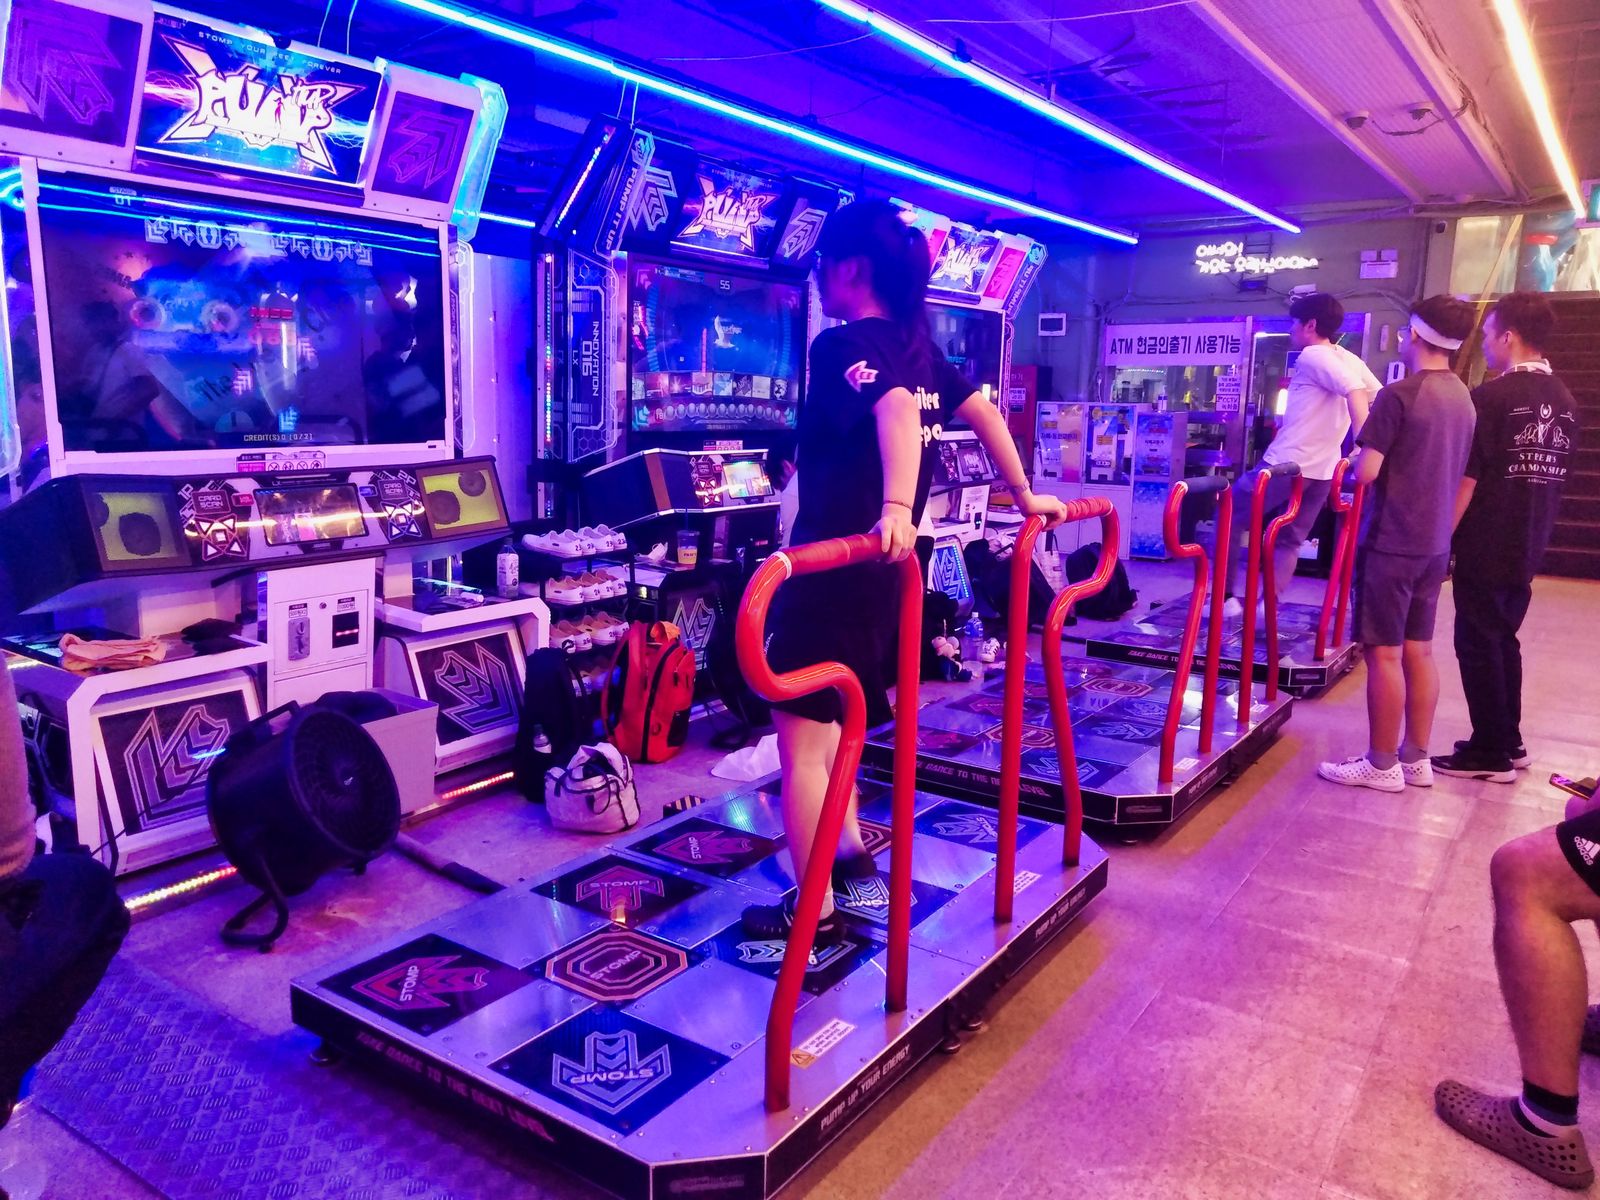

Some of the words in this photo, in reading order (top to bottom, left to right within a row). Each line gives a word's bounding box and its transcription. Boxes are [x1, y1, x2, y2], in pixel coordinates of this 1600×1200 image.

[198, 31, 233, 45] STOMP
[240, 43, 266, 55] YOUR
[302, 60, 342, 75] FOREVER
[620, 167, 638, 212] PUMP
[613, 212, 622, 230] IT
[605, 230, 616, 251] UP
[1110, 338, 1133, 354] ATM
[1136, 335, 1191, 355] 현금인출기
[1195, 334, 1241, 354] 사용가능
[573, 350, 578, 365] LX
[592, 320, 600, 397] INNOVATION
[397, 469, 416, 485] 2P
[177, 483, 194, 500] 1P
[199, 501, 224, 509] SCAN
[925, 763, 954, 774] DANCE
[957, 769, 968, 778] TO
[971, 773, 988, 783] THE
[690, 836, 699, 859] STOMP
[1574, 836, 1594, 865] adidas
[589, 880, 650, 889] STOMP
[589, 949, 641, 981] STOMP
[400, 965, 419, 1001] STOMP
[427, 1065, 442, 1083] TO
[446, 1075, 469, 1097] THE
[570, 1067, 655, 1084] STOMP
[821, 1101, 846, 1130] PUMP
[847, 1088, 859, 1106] UP
[861, 1069, 881, 1093] YOUR
[882, 1043, 911, 1076] ENERGY
